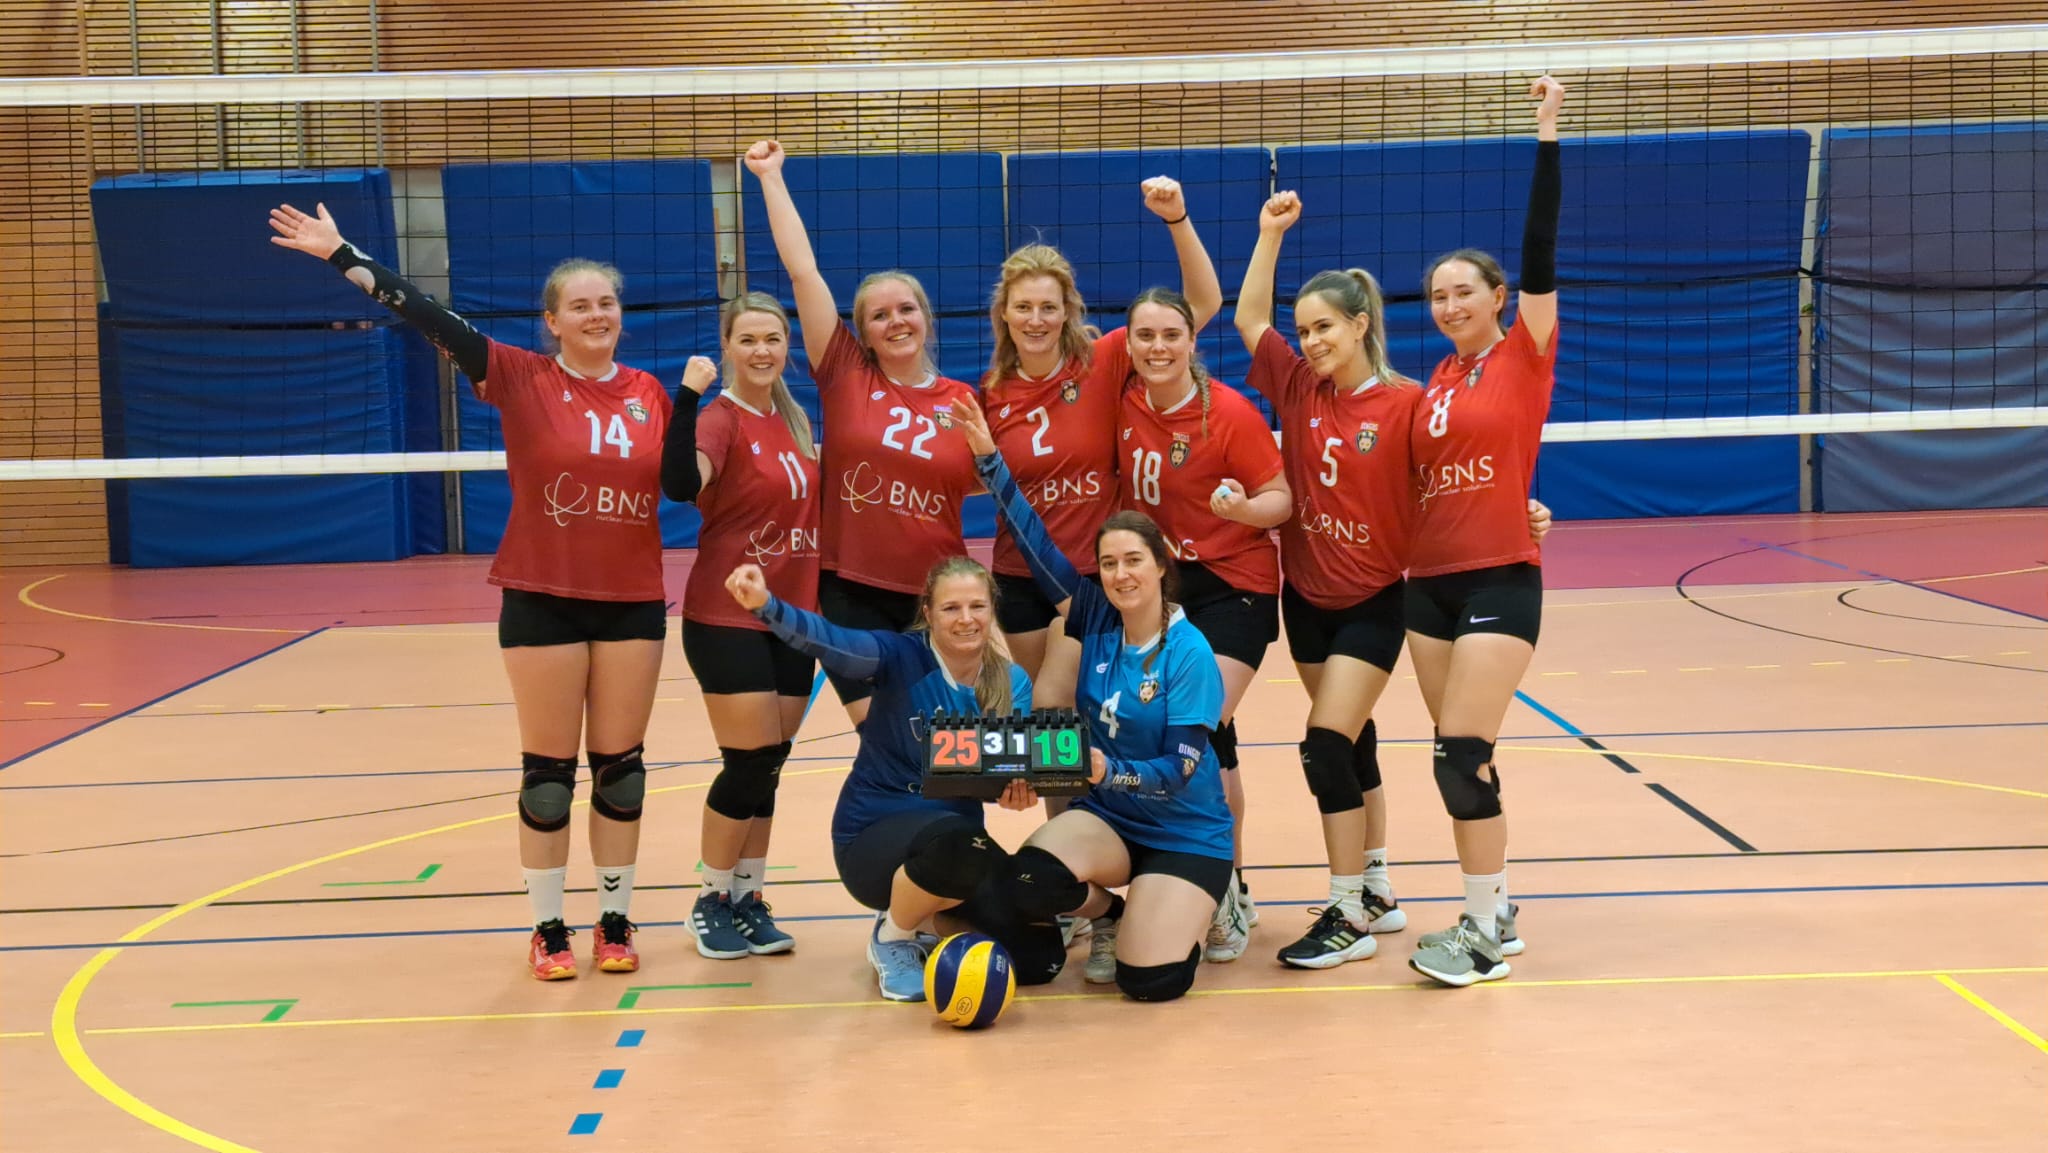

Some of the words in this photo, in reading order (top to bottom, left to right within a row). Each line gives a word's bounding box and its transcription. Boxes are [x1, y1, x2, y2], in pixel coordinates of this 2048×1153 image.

[583, 409, 634, 459] 14
[881, 406, 937, 460] 22
[1026, 405, 1054, 457] 2
[1428, 388, 1455, 438] 8
[778, 450, 808, 500] 11
[1043, 471, 1100, 502] BNS
[1132, 446, 1162, 506] 18
[1319, 436, 1344, 488] 5
[597, 486, 651, 519] BNS
[889, 480, 946, 515] BNS
[790, 527, 818, 551] BN
[1162, 534, 1199, 561] NS
[1099, 690, 1121, 739] 4
[932, 730, 979, 767] 25
[983, 731, 1003, 754] 3
[1012, 733, 1026, 755] 1
[1033, 729, 1080, 766] 19
